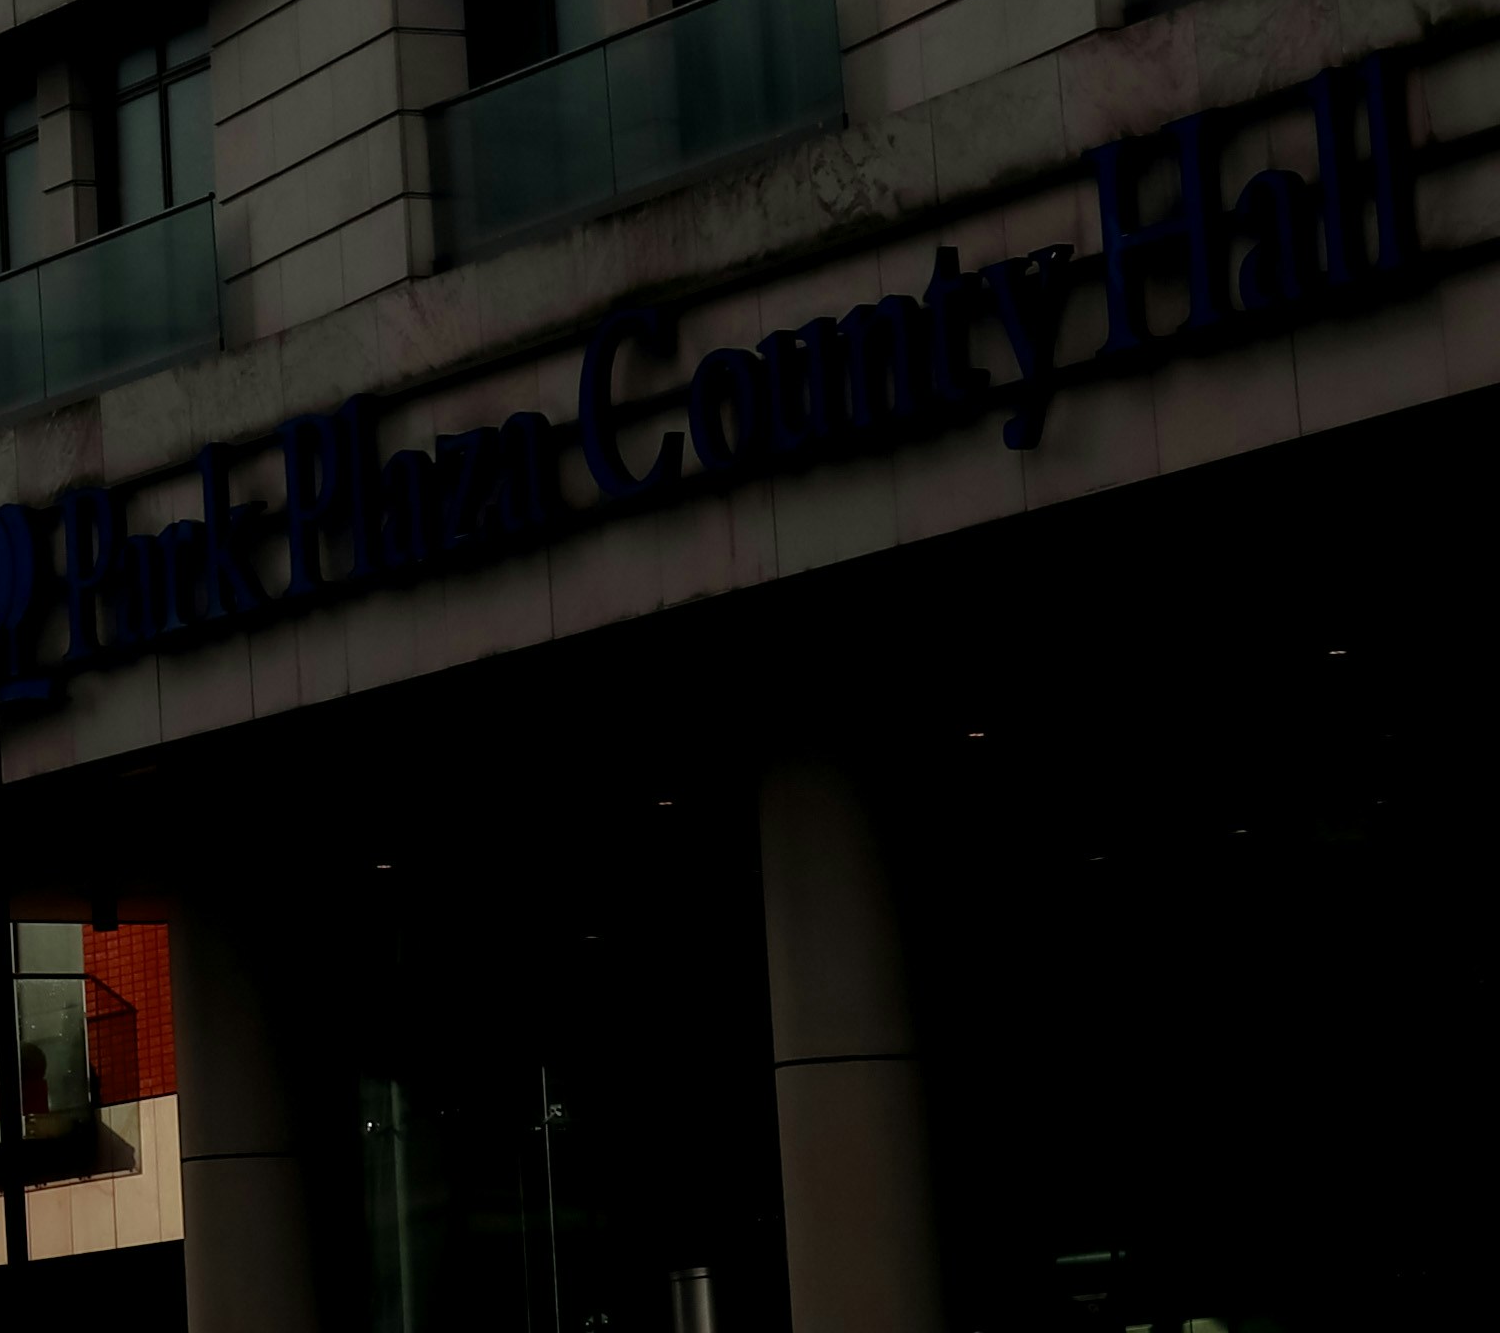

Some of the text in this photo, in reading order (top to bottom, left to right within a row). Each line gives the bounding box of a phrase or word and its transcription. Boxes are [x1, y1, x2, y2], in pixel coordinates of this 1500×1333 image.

[56, 49, 1415, 664] Park Plaza County Hall
